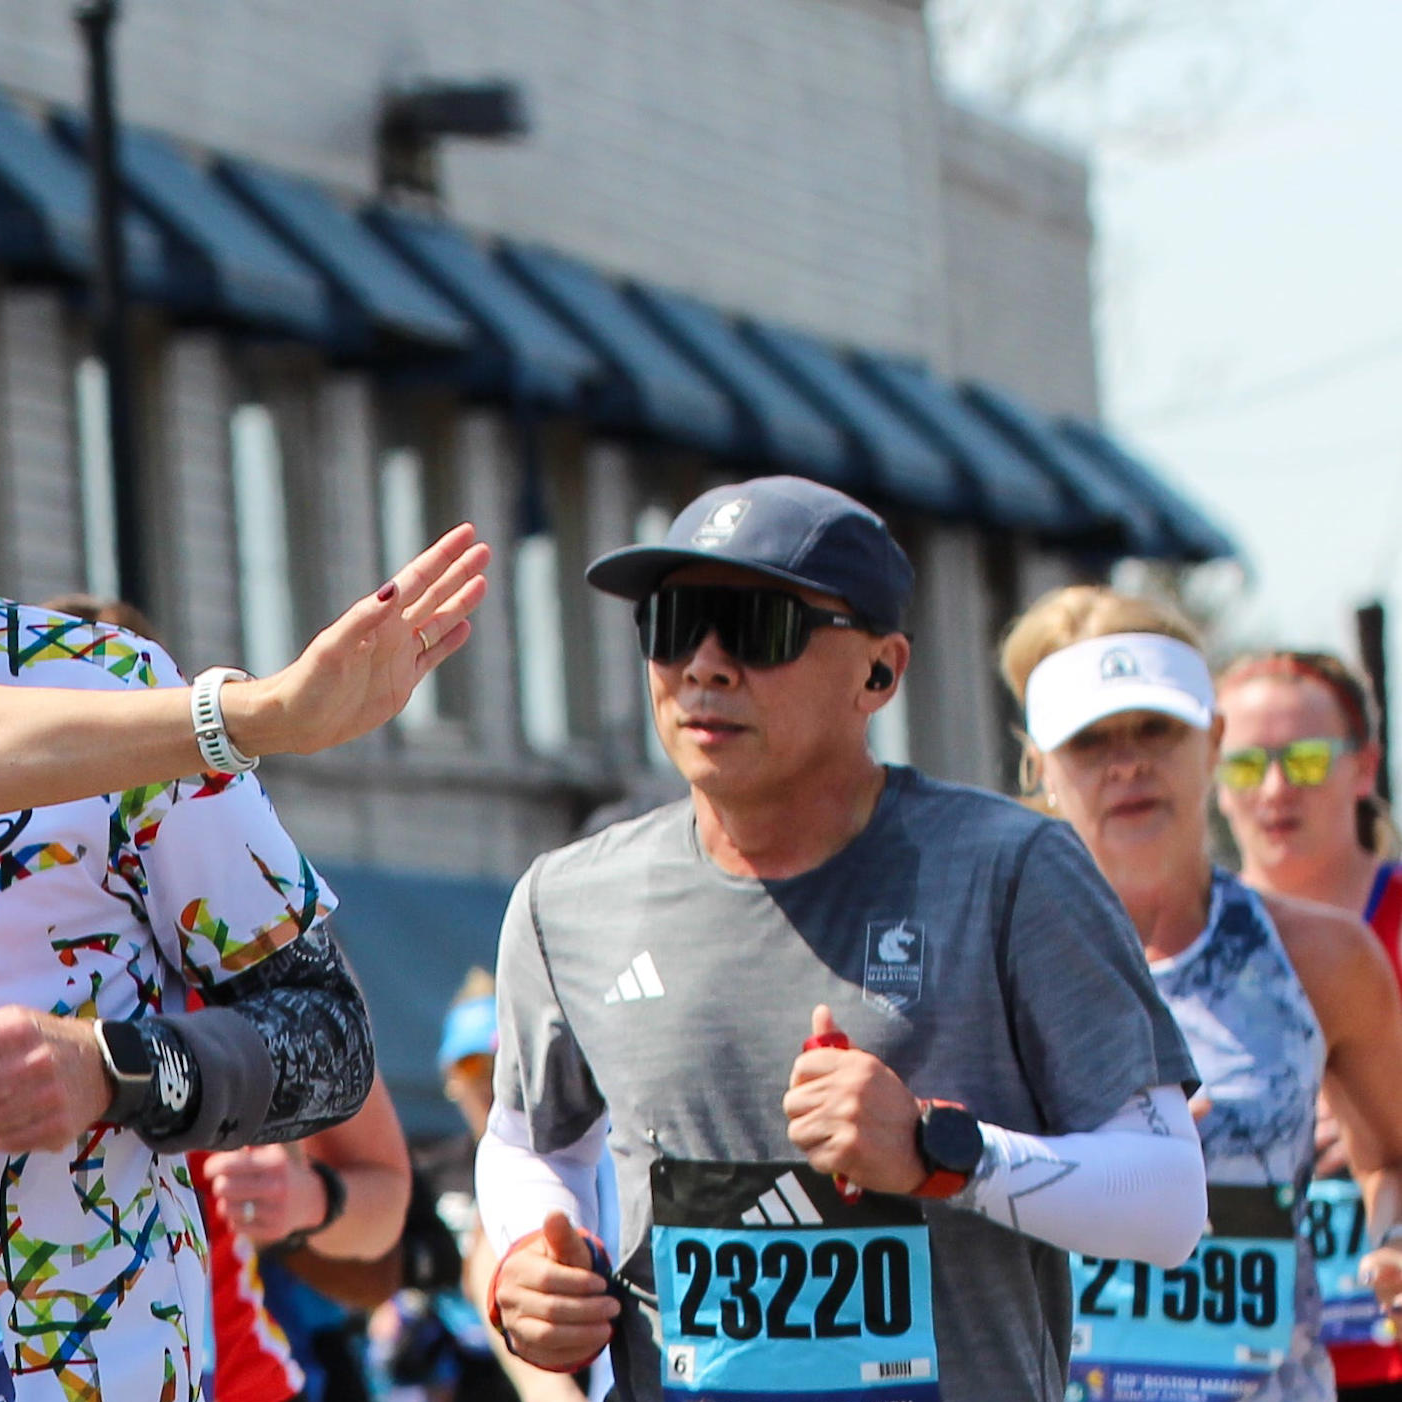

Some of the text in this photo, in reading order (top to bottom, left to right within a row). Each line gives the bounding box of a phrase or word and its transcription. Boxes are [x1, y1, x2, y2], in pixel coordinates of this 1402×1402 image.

[676, 1236, 912, 1341] 23220
[1080, 1247, 1277, 1328] 21599
[672, 1353, 687, 1375] 6
